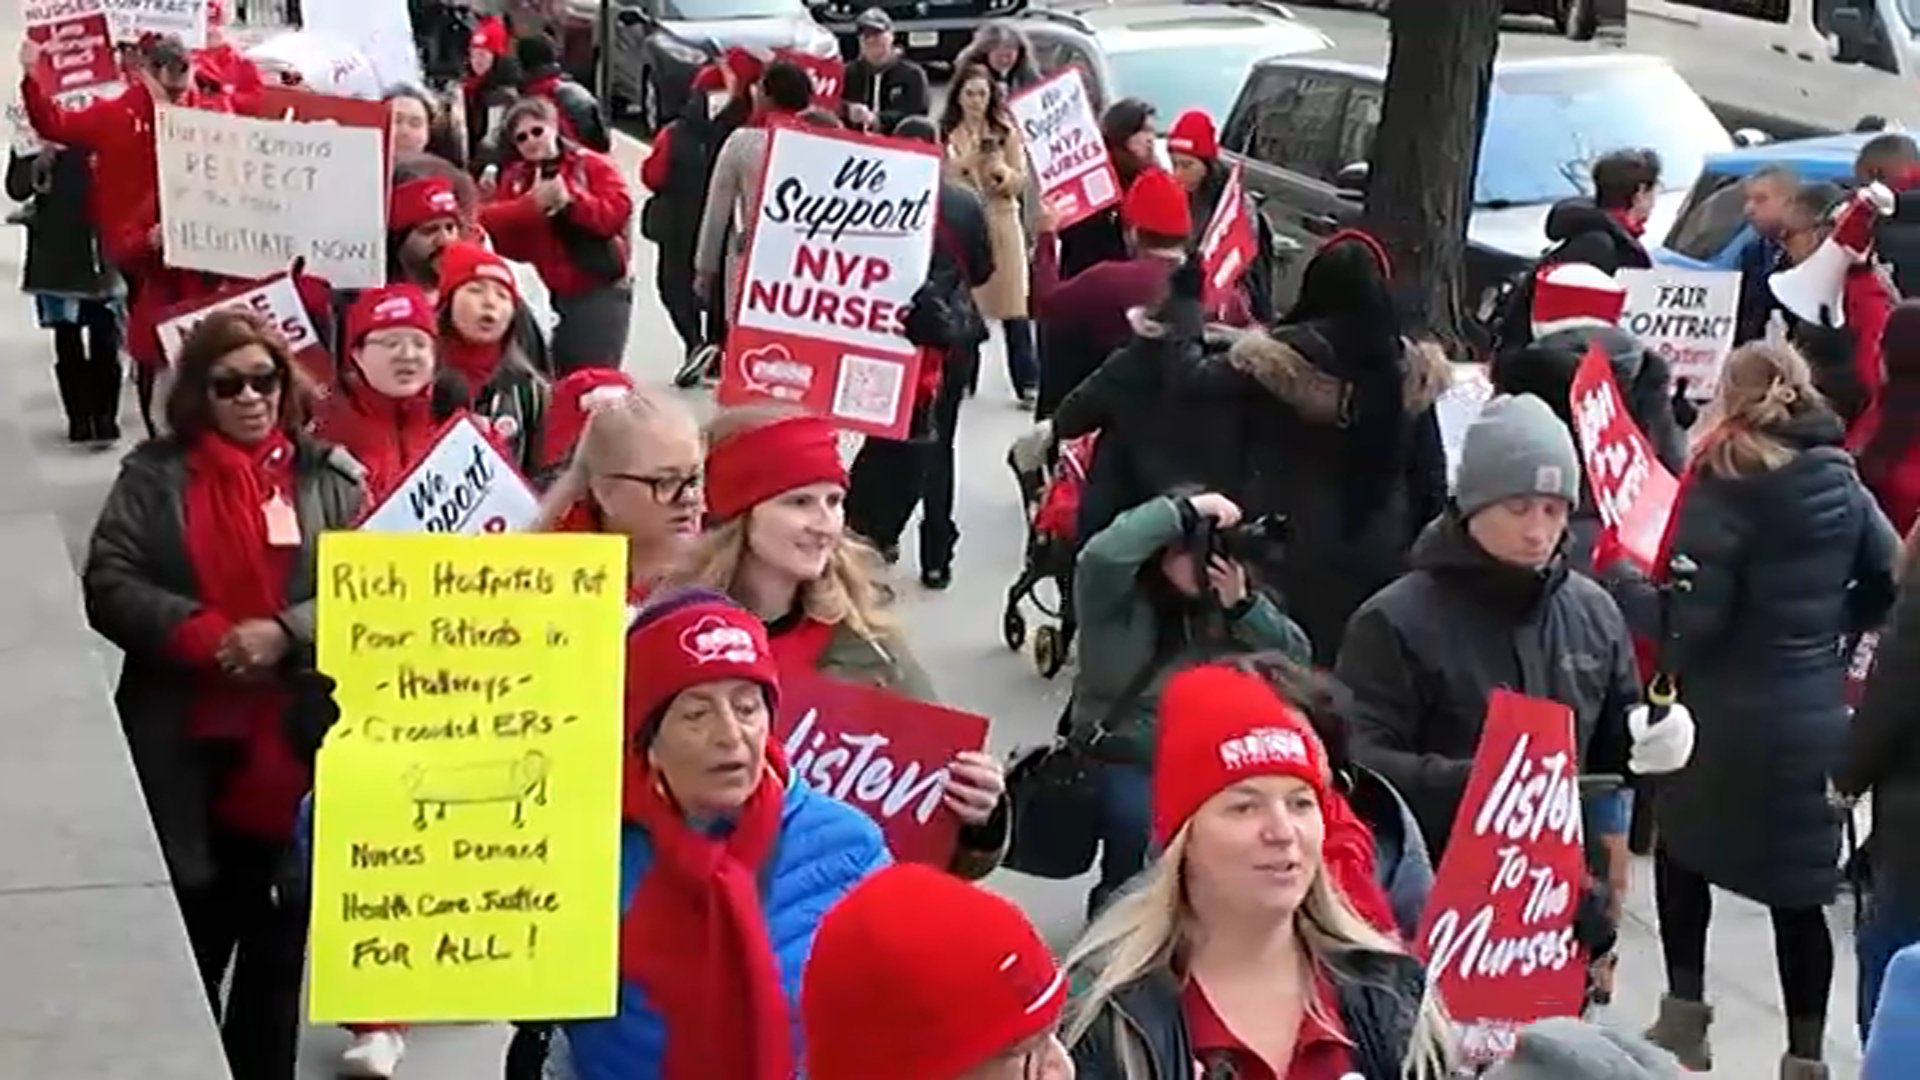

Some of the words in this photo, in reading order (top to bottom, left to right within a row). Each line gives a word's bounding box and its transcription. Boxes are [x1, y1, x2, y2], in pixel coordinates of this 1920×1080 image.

[833, 155, 888, 193] We
[764, 177, 931, 242] Support
[794, 244, 891, 290] NYP
[1658, 286, 1708, 308] FAIR
[1622, 312, 1733, 338] ONTRACT
[409, 469, 447, 520] We
[333, 562, 407, 602] Rich
[350, 622, 414, 653] Poor
[430, 617, 523, 648] Patients
[546, 622, 569, 647] in
[783, 708, 953, 825] listen
[350, 842, 426, 869] Nurses
[453, 837, 549, 863] Demand
[1490, 845, 1529, 895] To
[342, 891, 412, 923] Health
[418, 893, 470, 918] Care
[476, 886, 561, 914] Justice
[351, 936, 414, 971] FOR
